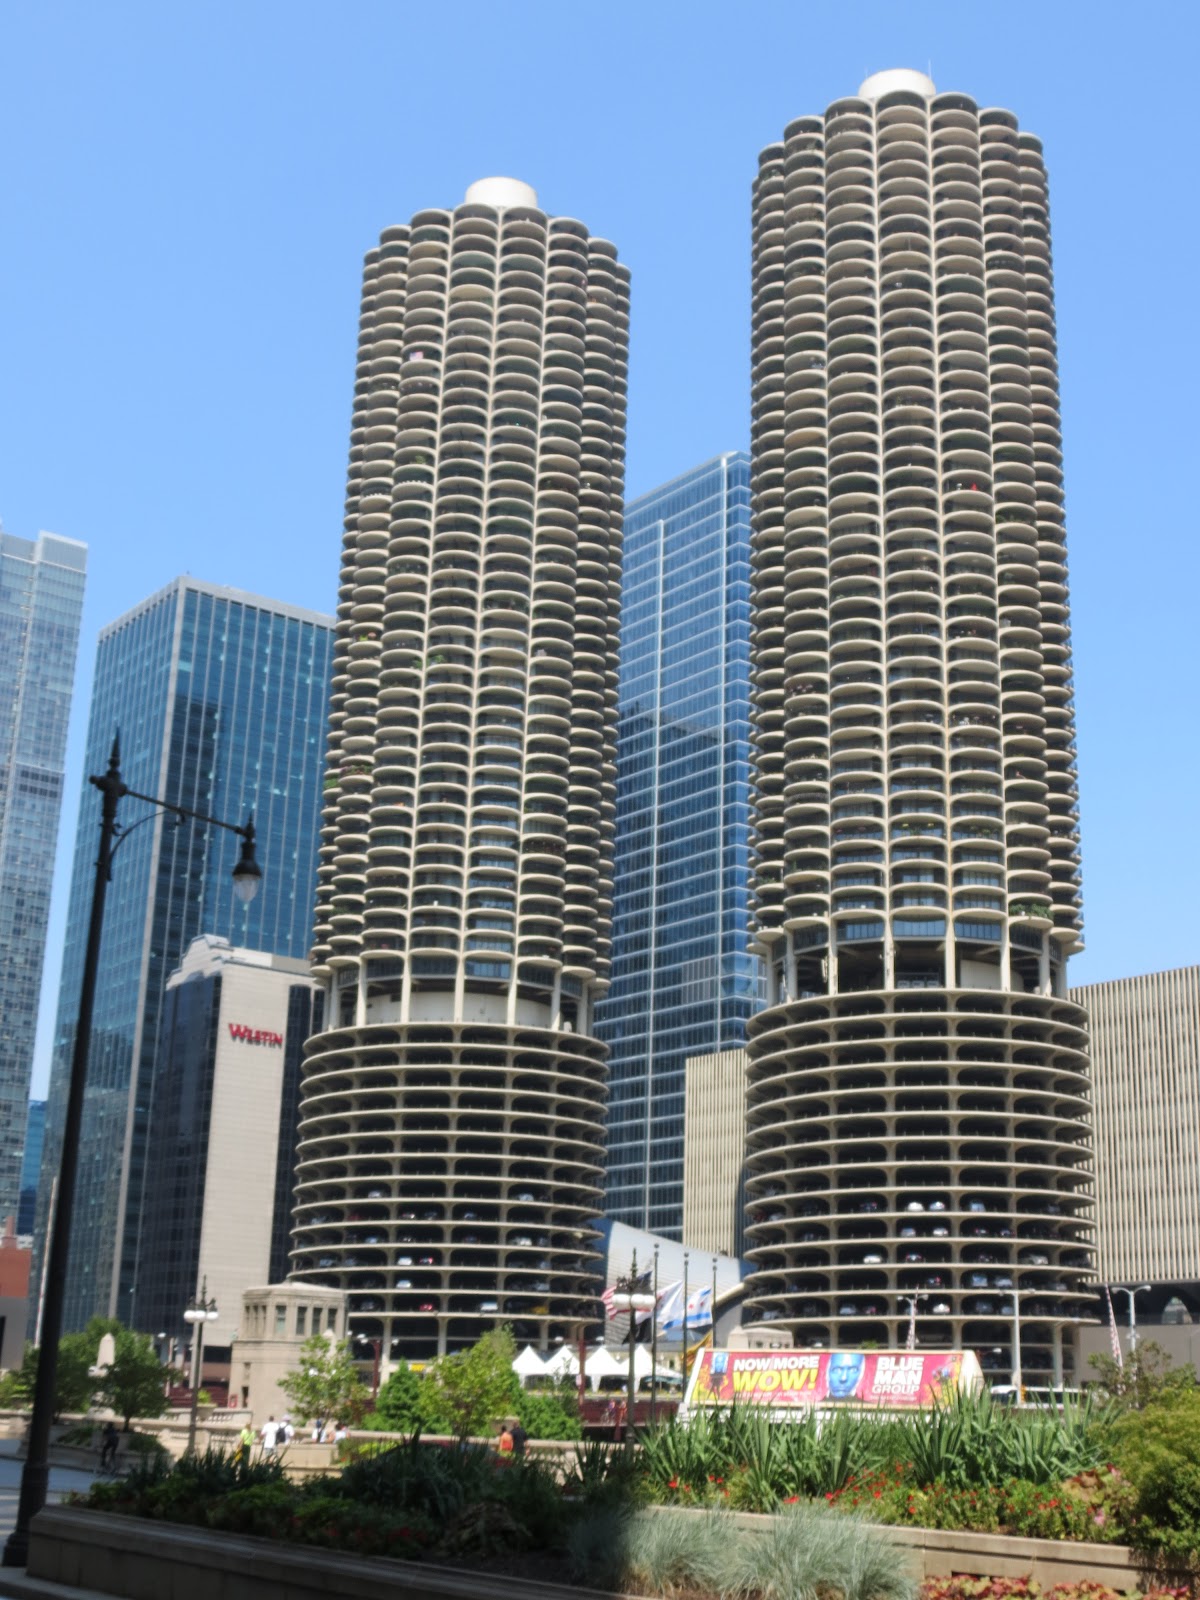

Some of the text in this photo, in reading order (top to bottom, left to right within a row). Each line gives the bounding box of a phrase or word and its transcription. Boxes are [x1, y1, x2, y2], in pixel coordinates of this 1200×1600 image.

[228, 1022, 283, 1046] WESTIN
[733, 1355, 820, 1372] NOW MORE
[876, 1356, 925, 1371] BLUE
[732, 1368, 818, 1393] WOW!
[874, 1370, 923, 1385] MAN
[871, 1384, 920, 1395] GROUP
